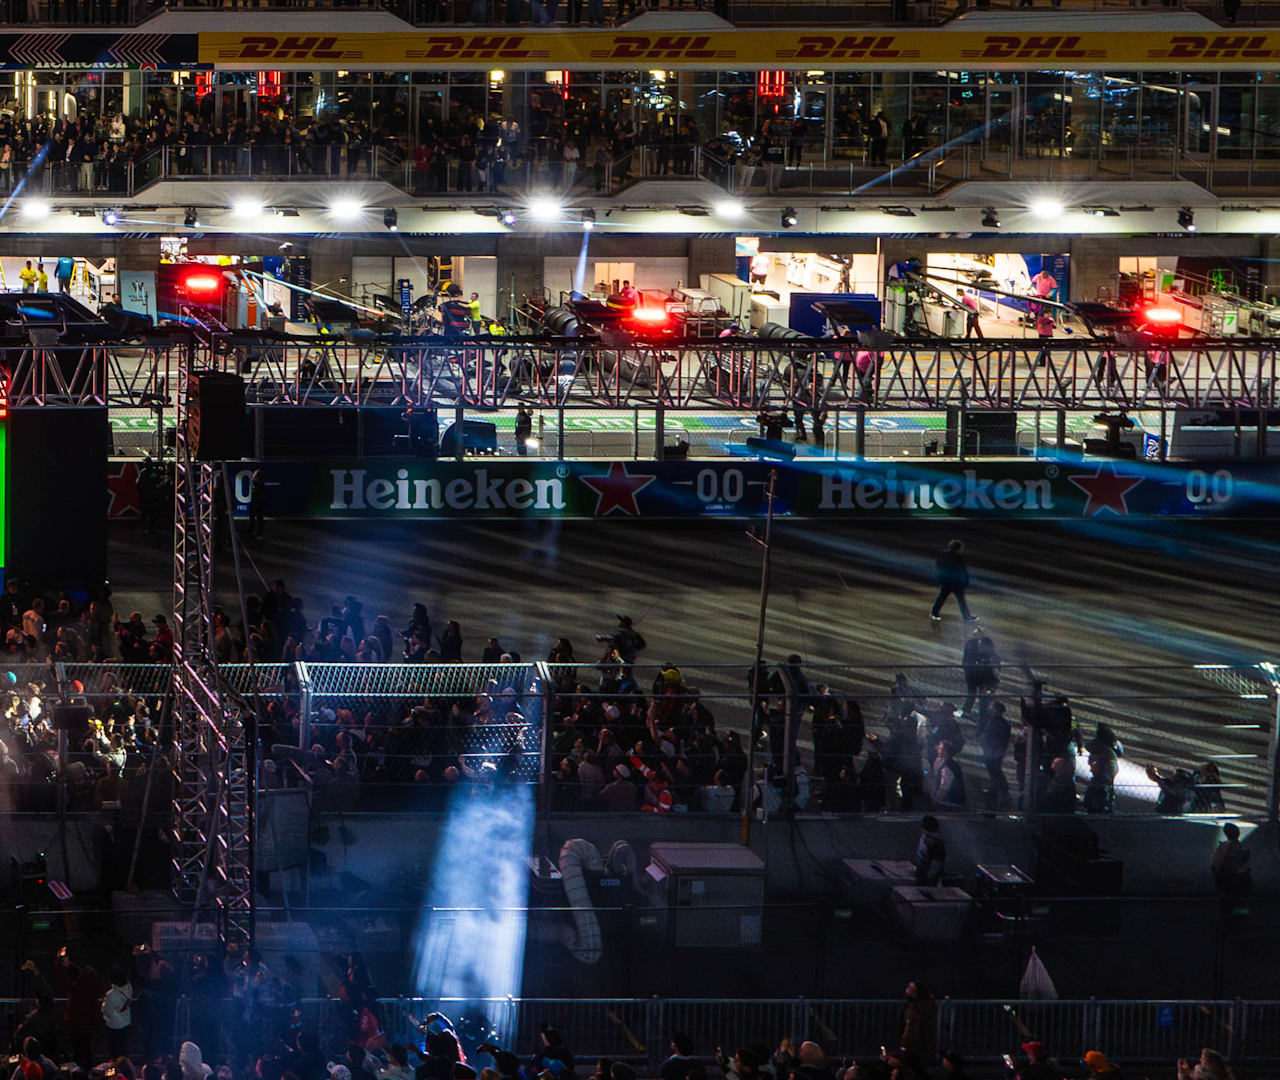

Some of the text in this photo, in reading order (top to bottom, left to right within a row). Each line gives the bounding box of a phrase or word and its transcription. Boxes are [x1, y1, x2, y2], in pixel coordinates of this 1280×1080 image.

[239, 36, 343, 58] DHL
[426, 36, 530, 58] DHL
[612, 36, 717, 58] DHL
[797, 36, 903, 58] DHL
[984, 36, 1089, 58] DHL
[1170, 36, 1275, 58] DHL
[697, 469, 744, 503] 0.0
[1186, 469, 1233, 504] 0.0
